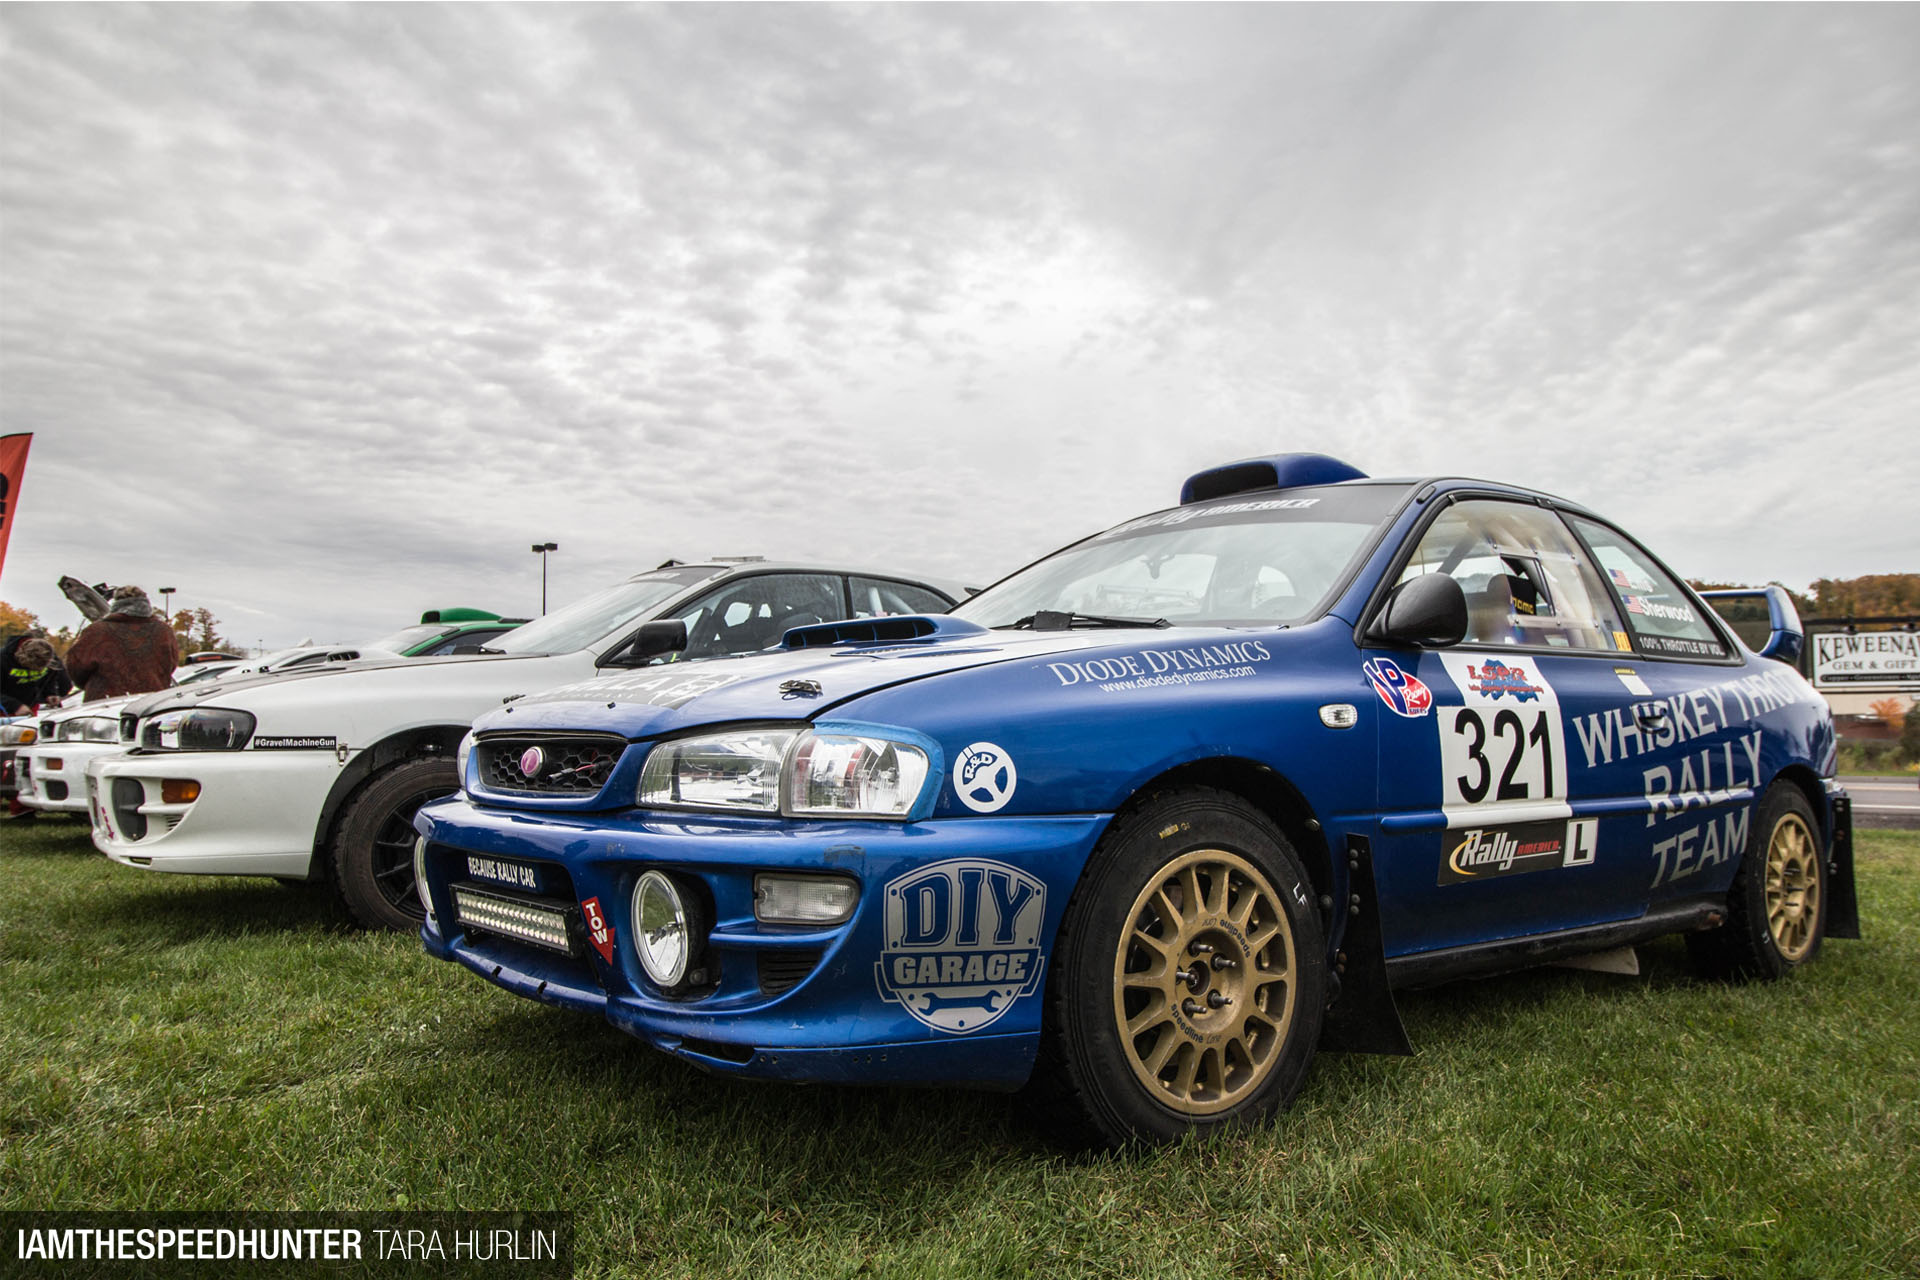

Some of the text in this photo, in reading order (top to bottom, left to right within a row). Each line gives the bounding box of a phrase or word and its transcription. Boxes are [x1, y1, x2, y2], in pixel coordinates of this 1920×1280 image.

[1637, 596, 1695, 623] Sherwood
[1661, 638, 1699, 654] THROTTLE
[1818, 634, 1920, 667] KEWEENA
[1047, 640, 1271, 686] DIODE DYNAMICS
[1099, 665, 1257, 693] www.diodedynamics.com
[1467, 665, 1528, 681] LSPR
[1832, 661, 1863, 671] GEM
[1869, 661, 1878, 669] &
[1403, 686, 1427, 706] Racing
[255, 738, 335, 747] #GravelMachineGun
[1454, 708, 1554, 804] 321
[1643, 730, 1762, 828] RALLY
[1460, 829, 1560, 871] Rally AMERICA
[1573, 823, 1589, 861] L
[1651, 806, 1750, 889] TEAM
[468, 856, 536, 888] BECAUSE RALLY CAR
[586, 903, 608, 945] TOW
[900, 868, 1035, 947] DIY
[893, 953, 1030, 985] GARAGE
[1171, 1003, 1204, 1044] speedline
